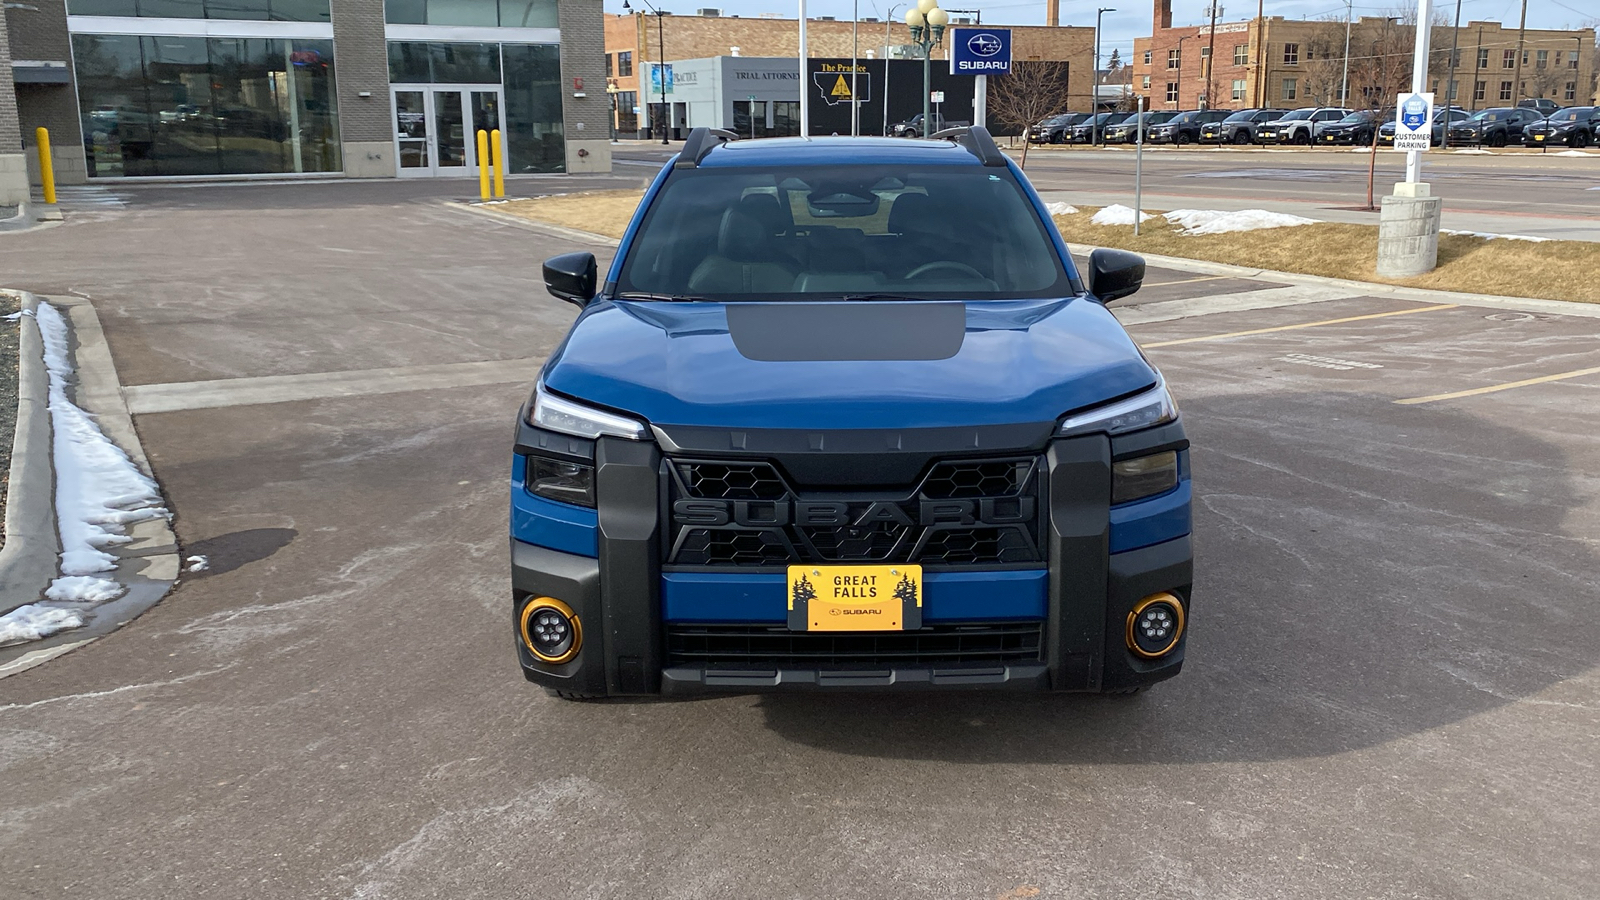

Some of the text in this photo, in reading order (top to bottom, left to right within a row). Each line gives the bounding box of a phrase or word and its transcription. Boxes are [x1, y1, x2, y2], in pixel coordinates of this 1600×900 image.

[821, 63, 867, 72] The Pracice
[959, 61, 1008, 70] SUBARU
[735, 72, 760, 80] TRIAL
[1395, 133, 1431, 141] CUSTOMER
[673, 499, 1036, 527] SUBARU
[833, 575, 877, 586] GREAT
[834, 587, 877, 598] FALLS
